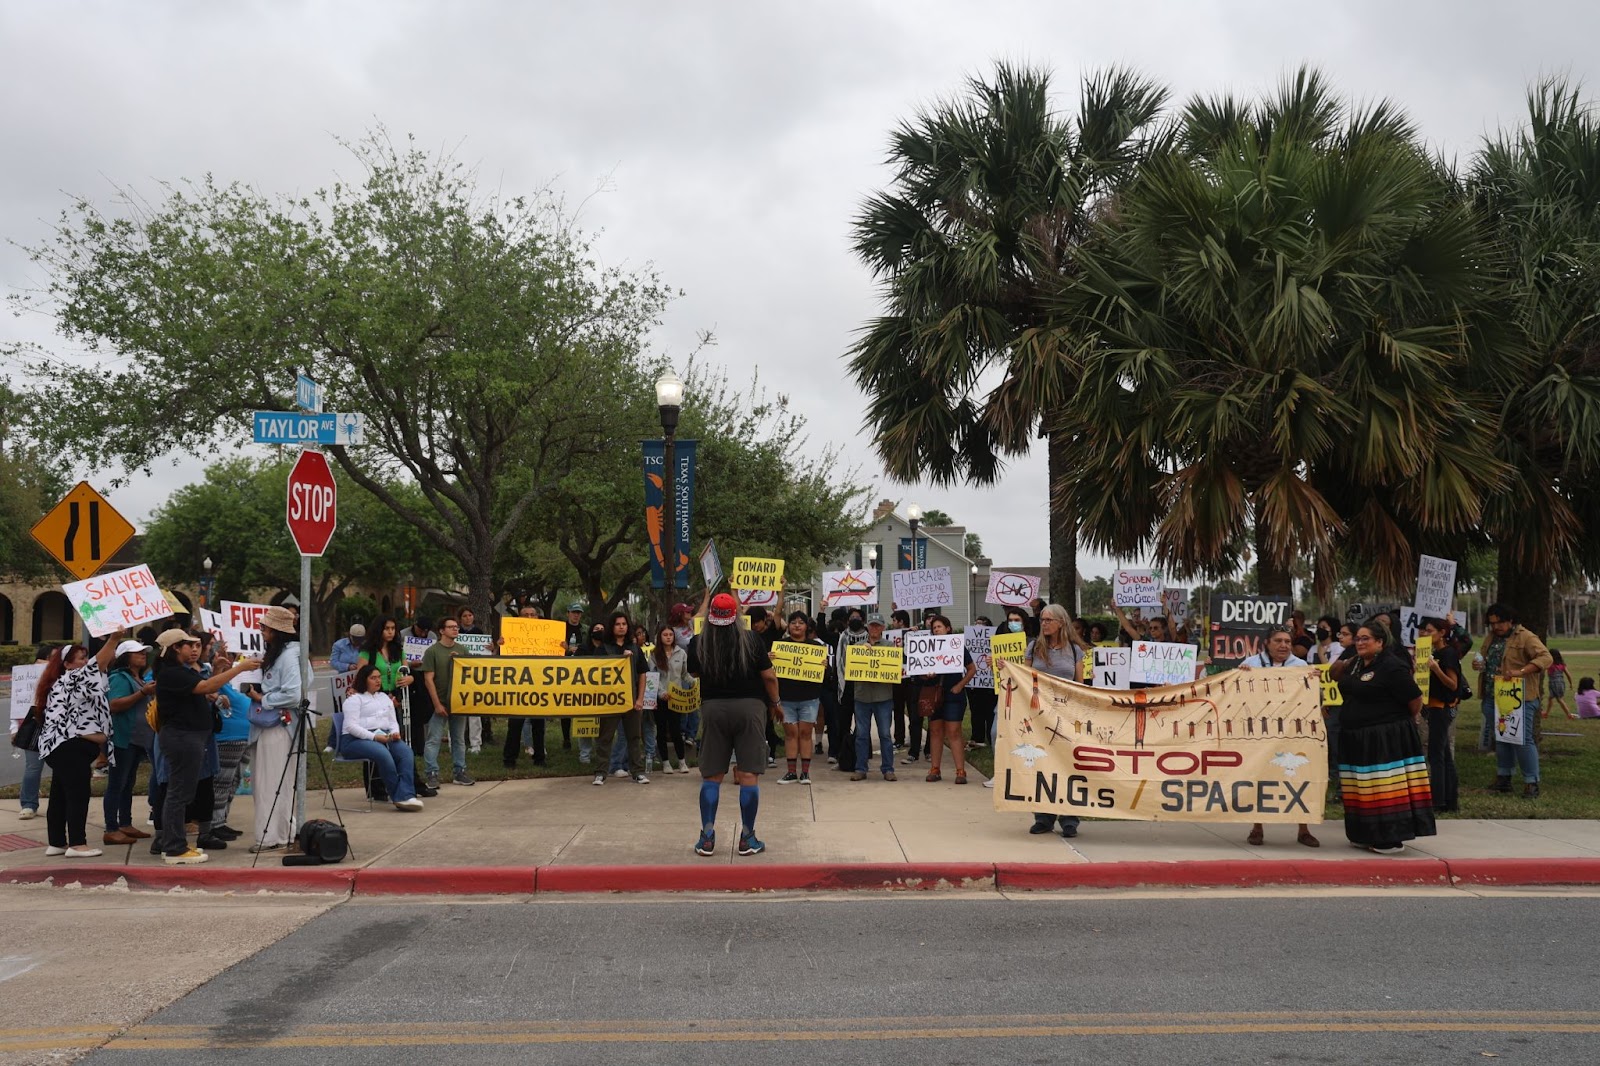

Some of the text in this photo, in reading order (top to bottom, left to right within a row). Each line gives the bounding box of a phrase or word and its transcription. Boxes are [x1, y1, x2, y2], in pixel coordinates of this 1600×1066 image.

[259, 419, 334, 439] TAYLOR AVE
[644, 456, 664, 465] TSC
[291, 482, 333, 522] STOP
[681, 456, 689, 543] TEXAS SOUTHMOST
[738, 561, 776, 573] COWARD
[85, 568, 155, 601] SALVEN
[736, 574, 775, 587] COWEN
[893, 570, 934, 589] FUERA
[1118, 572, 1152, 585] SALVEN
[895, 583, 945, 598] DENY DEFEND
[122, 592, 146, 607] LA
[900, 593, 935, 606] DEPOSE
[1117, 593, 1156, 604] BOCA CHICA
[1221, 600, 1288, 625] DEPORT
[507, 621, 551, 632] TRUMP
[973, 628, 990, 639] WE
[240, 631, 267, 652] LN
[406, 636, 433, 646] KEEP
[456, 635, 492, 643] ROTECT
[508, 636, 540, 647] MUSK
[909, 638, 946, 653] DONT
[776, 643, 824, 657] PROGRESS FOR
[851, 647, 900, 659] PROGRESS FOR
[993, 641, 1022, 654] DIVEST
[1139, 645, 1188, 660] SALVEN
[1213, 635, 1259, 659] ELON
[792, 657, 803, 666] US
[869, 659, 880, 669] US
[908, 655, 936, 671] PASS
[943, 654, 962, 667] GAS
[1095, 651, 1126, 667] LIES
[773, 665, 821, 680] NOT FOR MUSK
[849, 669, 863, 677] NOT
[865, 670, 878, 679] FOR
[880, 671, 899, 680] MUSK
[1142, 659, 1191, 675] LA PLAYA
[461, 666, 626, 686] FUERA SPACEX
[1104, 671, 1116, 686] N
[459, 691, 470, 706] Y
[473, 691, 549, 707] POLITICOS
[552, 691, 626, 707] VENDIDOS
[671, 703, 697, 711] NOT FOR
[577, 727, 599, 735] NOT FO
[1072, 745, 1243, 776] STOP
[1004, 768, 1310, 814] L.N.G.s / SPACE-X
